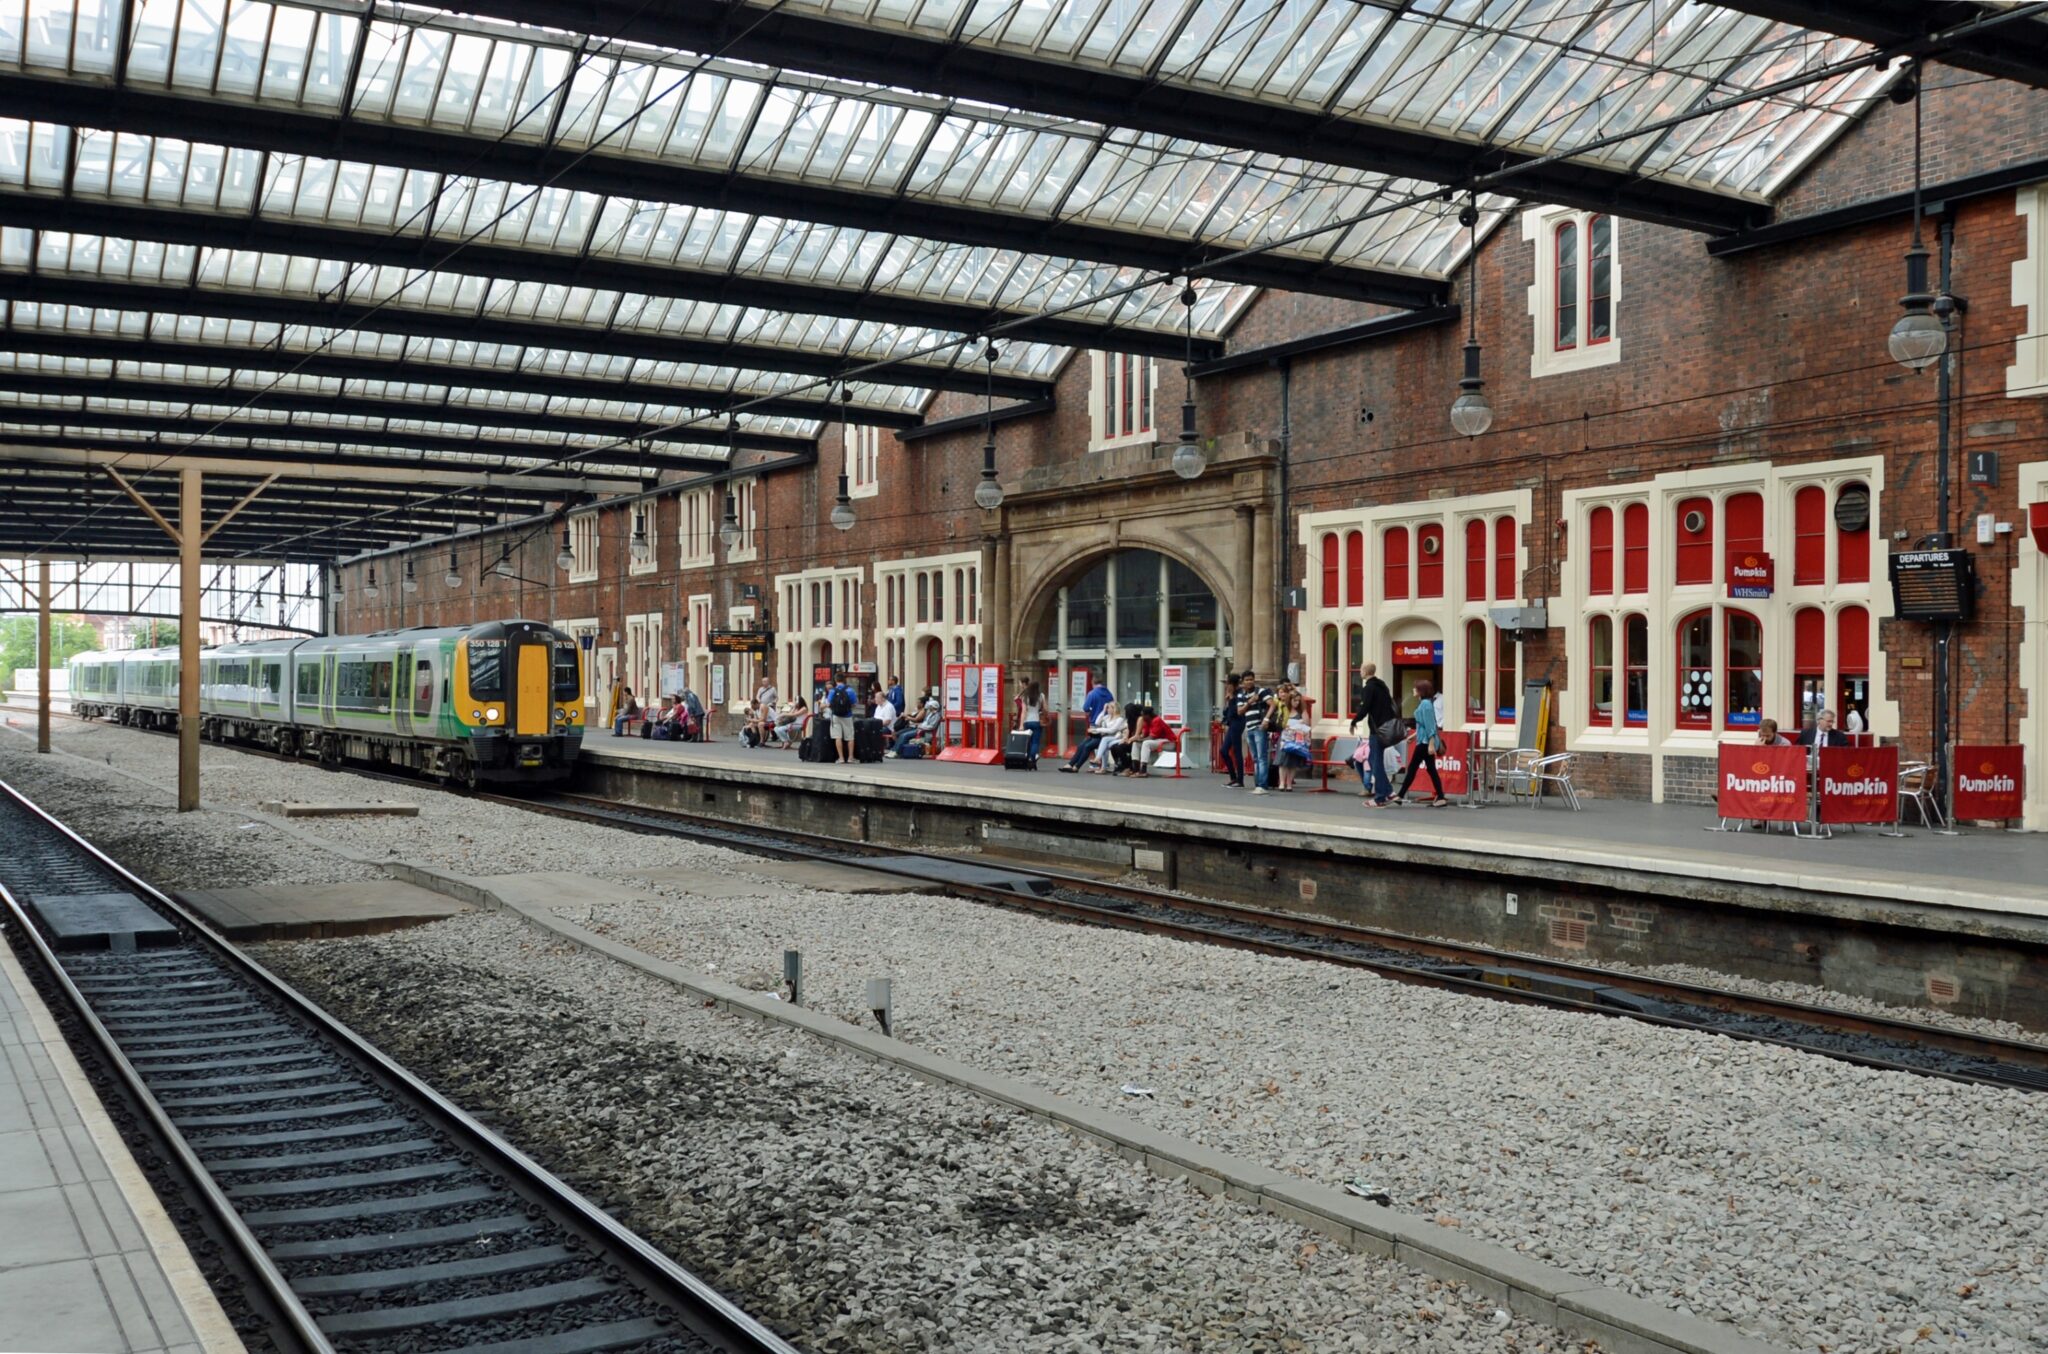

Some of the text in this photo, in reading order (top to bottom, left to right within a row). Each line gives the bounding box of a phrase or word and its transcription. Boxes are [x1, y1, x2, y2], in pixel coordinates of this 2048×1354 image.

[1977, 454, 1983, 471] 1
[1899, 552, 1950, 563] DEPARTURES
[1734, 566, 1767, 577] Pumpkin
[1290, 590, 1297, 606] 1
[1734, 587, 1768, 597] WHSmith
[470, 640, 500, 648] 350 128
[1404, 646, 1429, 655] Pumpkin
[1726, 773, 1796, 794] Pumpkin
[1825, 777, 1888, 795] Pumpkin
[1959, 774, 2015, 792] Pumpkin
